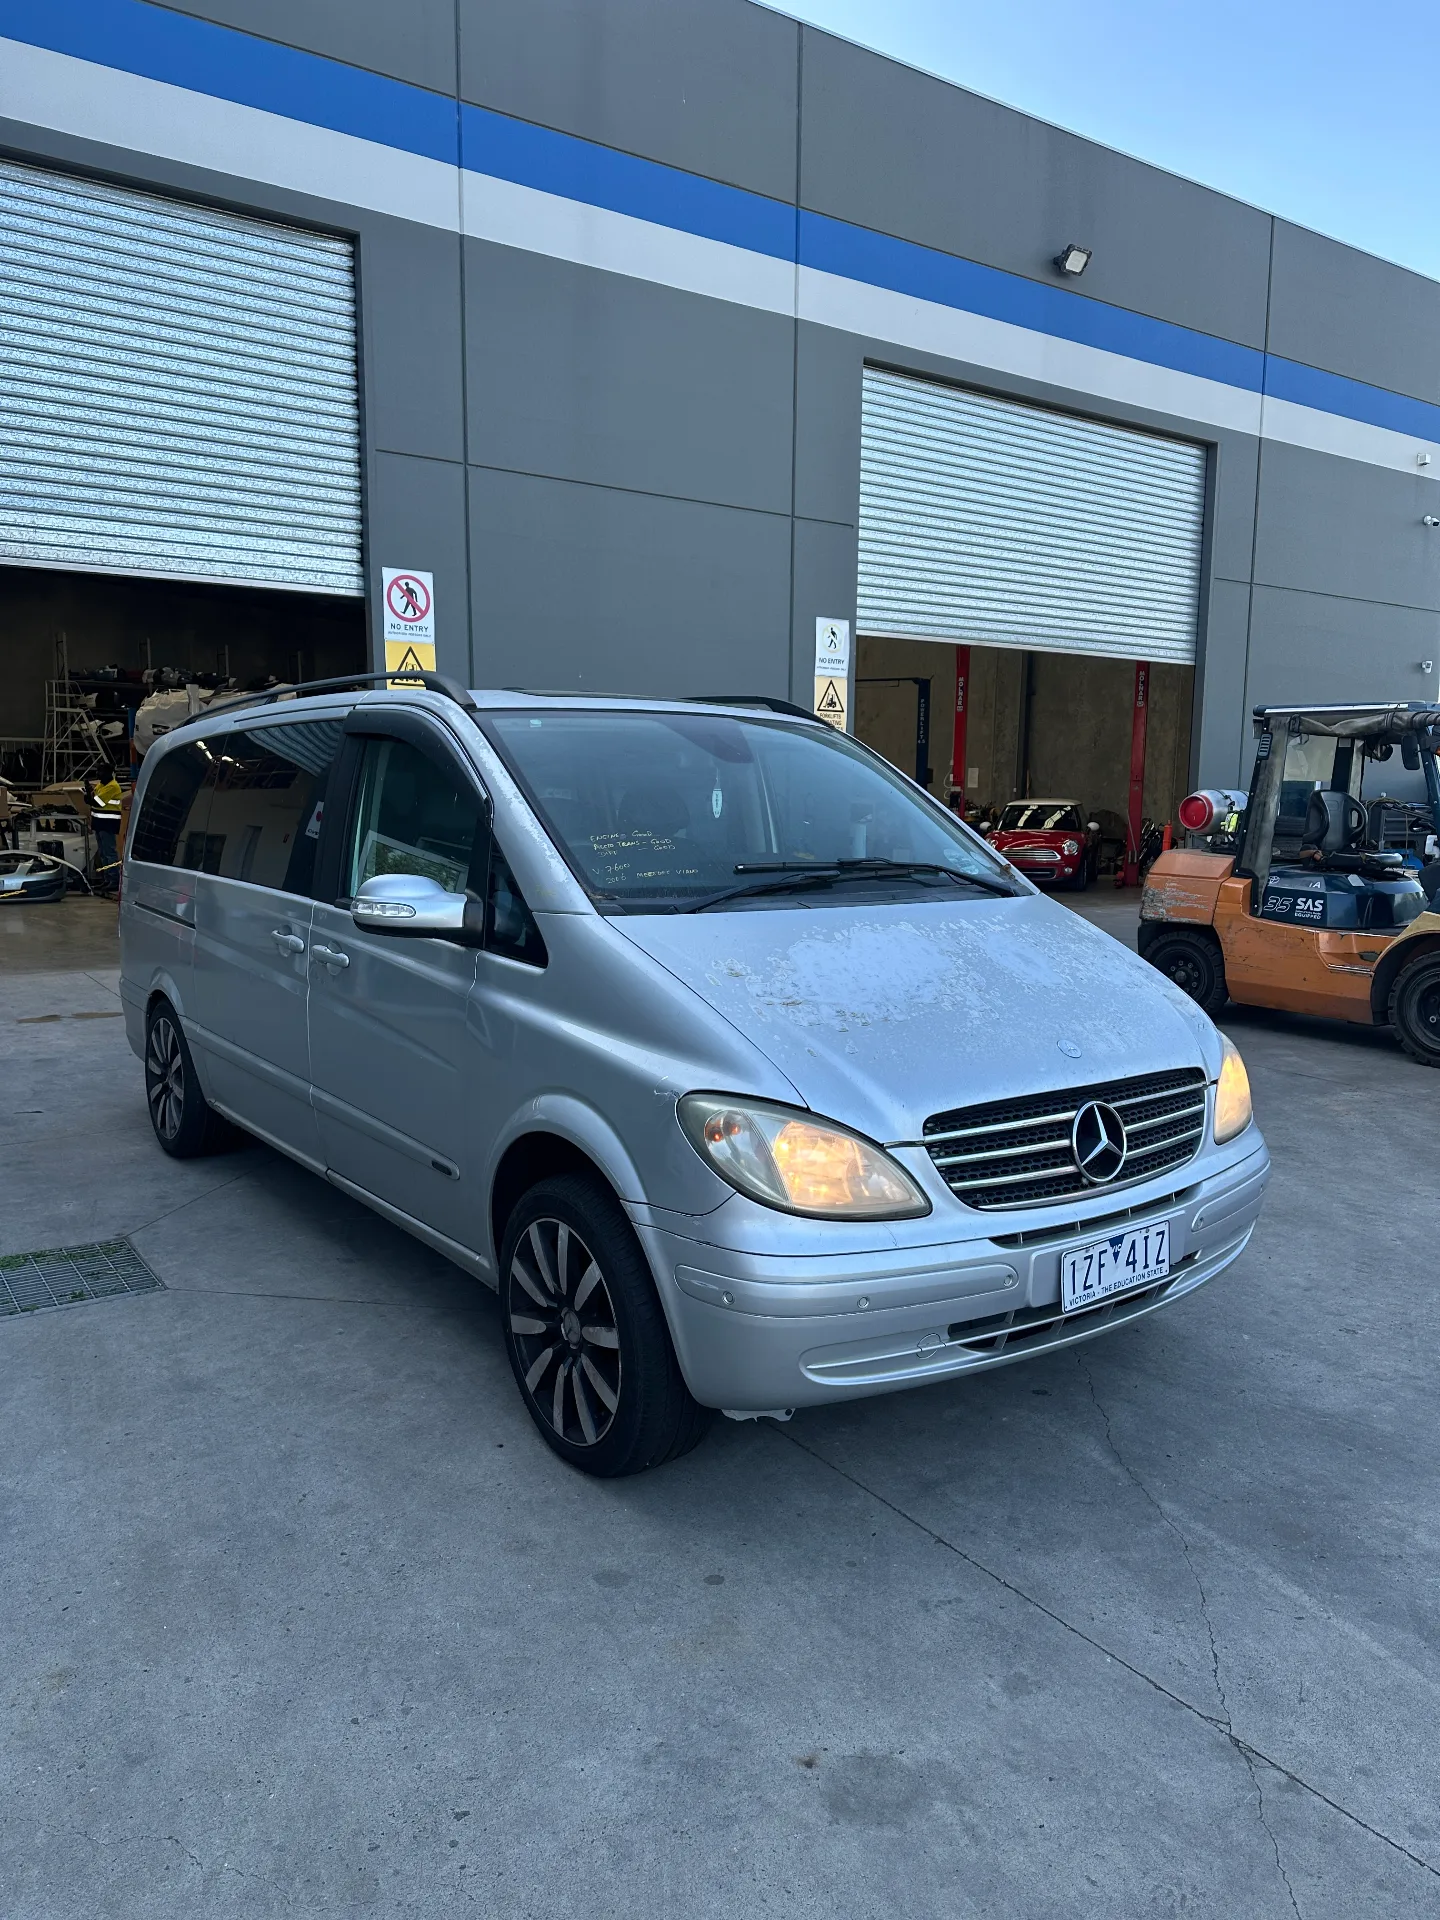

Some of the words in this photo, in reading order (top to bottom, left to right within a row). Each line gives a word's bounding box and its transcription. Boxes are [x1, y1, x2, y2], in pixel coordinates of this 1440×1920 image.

[390, 622, 401, 630] NO
[404, 624, 429, 633] ENTRY
[1263, 895, 1293, 913] 35
[1296, 897, 1324, 912] SAS
[1070, 1249, 1108, 1295] 1ZF
[1069, 1291, 1096, 1306] VICTORIA
[1101, 1282, 1113, 1294] THE
[1113, 1273, 1146, 1287] EDUCATION
[1147, 1266, 1163, 1278] STATE
